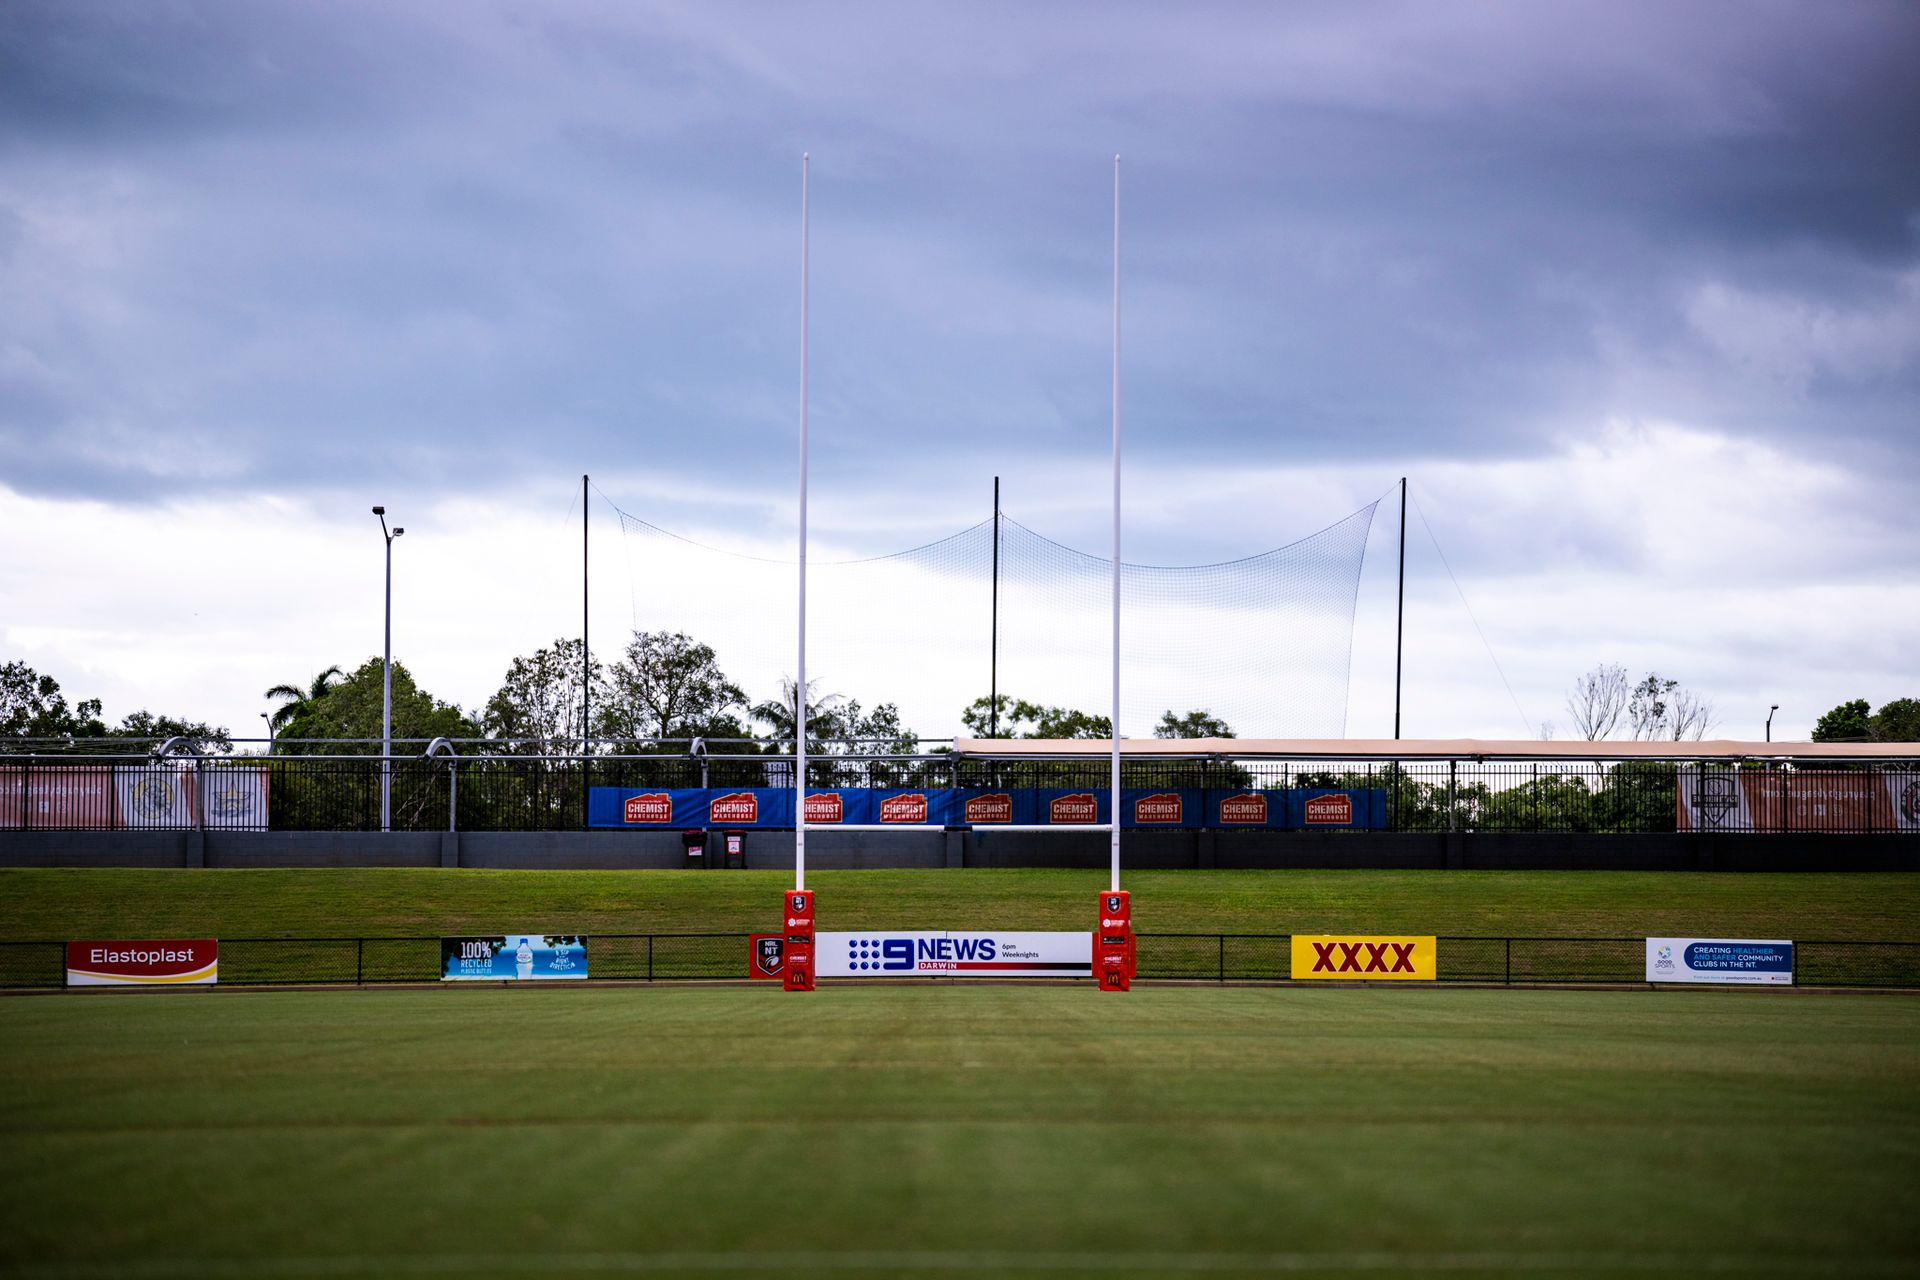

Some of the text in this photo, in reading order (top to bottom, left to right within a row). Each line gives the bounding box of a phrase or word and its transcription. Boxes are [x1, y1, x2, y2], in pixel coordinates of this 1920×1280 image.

[628, 804, 668, 813] CHEMIST
[713, 804, 754, 813] CHEMIST
[804, 804, 839, 813] HEMIST
[884, 804, 924, 814] CHEMIST
[968, 804, 1009, 814] CHEMIST
[1054, 804, 1094, 814] CHEMIST
[1138, 804, 1178, 814] CHEMIST
[1223, 804, 1264, 814] CHEMIST
[1308, 804, 1349, 814] CHEMIST
[461, 942, 492, 958] 100%
[883, 939, 996, 970] 9 NEWS
[1002, 951, 1039, 959] Weeknights
[90, 948, 194, 965] Elastoplast
[1311, 942, 1416, 973] XXXX
[461, 959, 492, 968] RECYCLED
